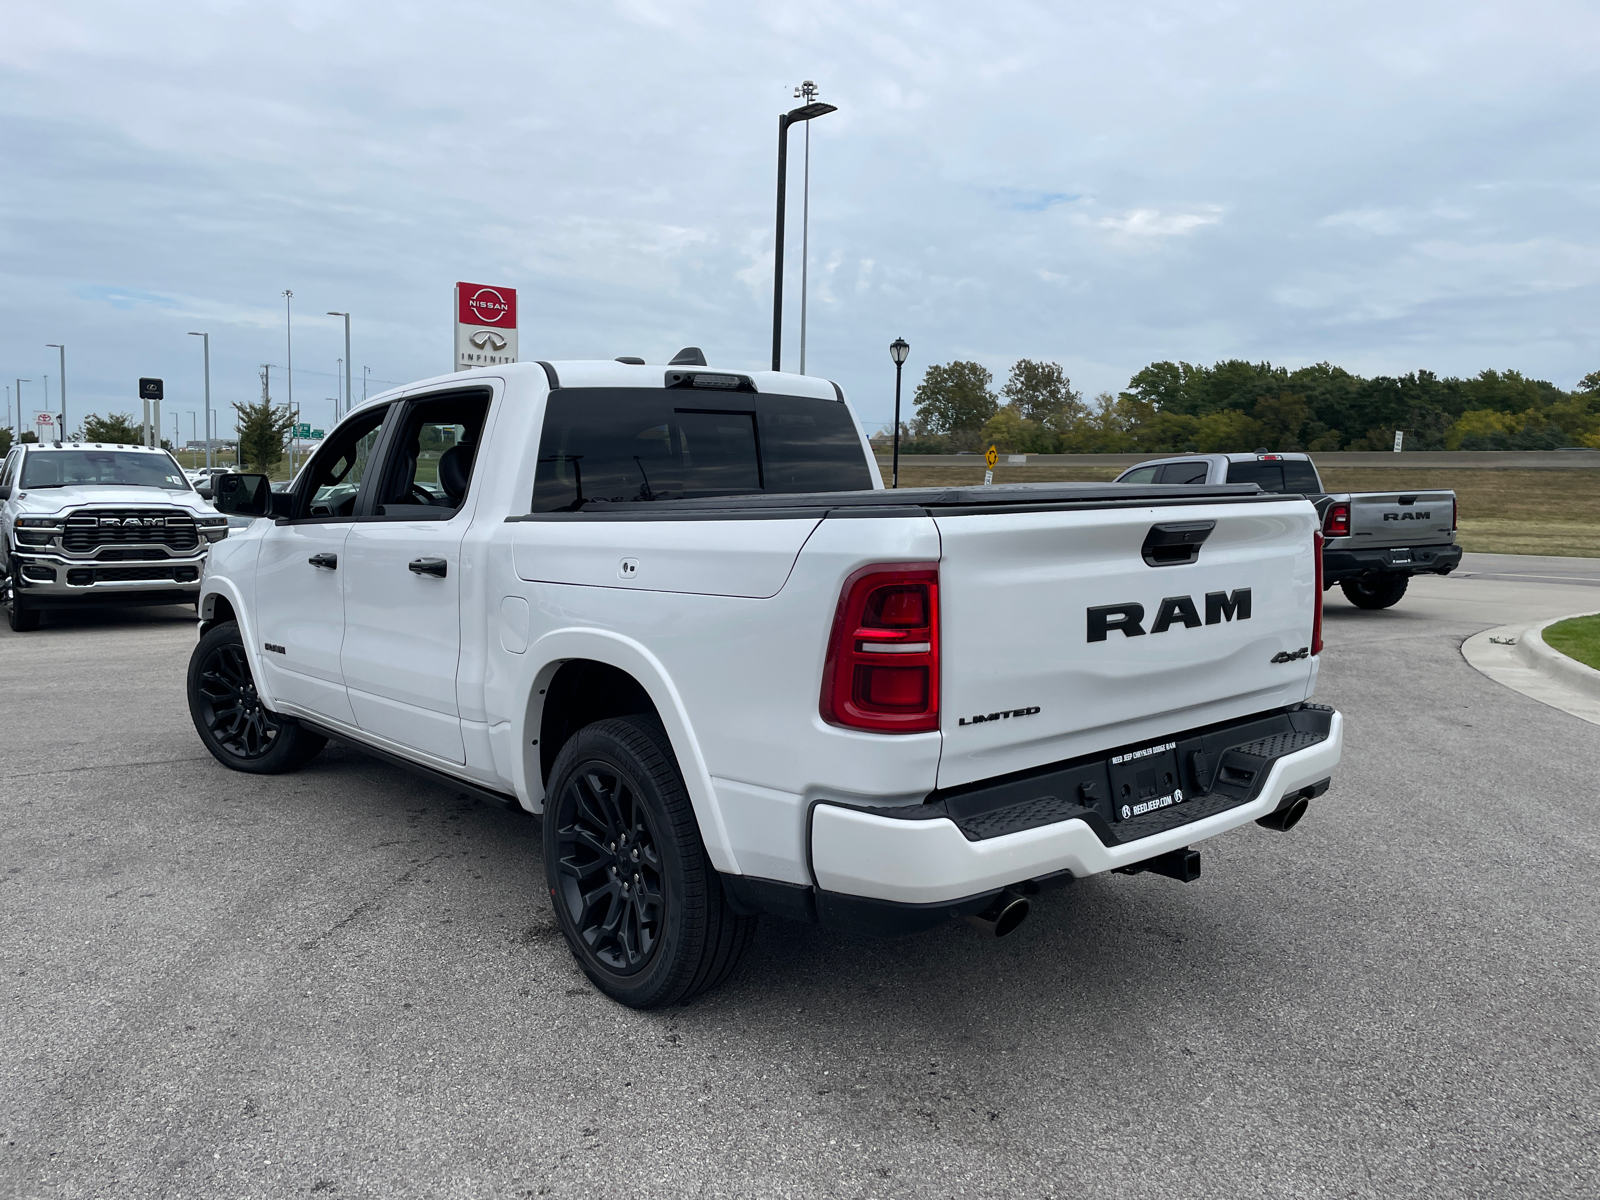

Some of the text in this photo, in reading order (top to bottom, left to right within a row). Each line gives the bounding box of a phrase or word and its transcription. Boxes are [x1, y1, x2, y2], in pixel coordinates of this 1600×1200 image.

[469, 299, 508, 311] NISSAN
[461, 352, 515, 364] INFINITI
[99, 517, 165, 527] RAM
[1383, 511, 1431, 522] RAM
[1086, 587, 1252, 644] RAM
[958, 705, 1041, 726] LIMITED
[1112, 742, 1176, 765] REED JEEP CHRYSLER DODGE RAM
[1132, 796, 1172, 816] REEDJEEP.COM
